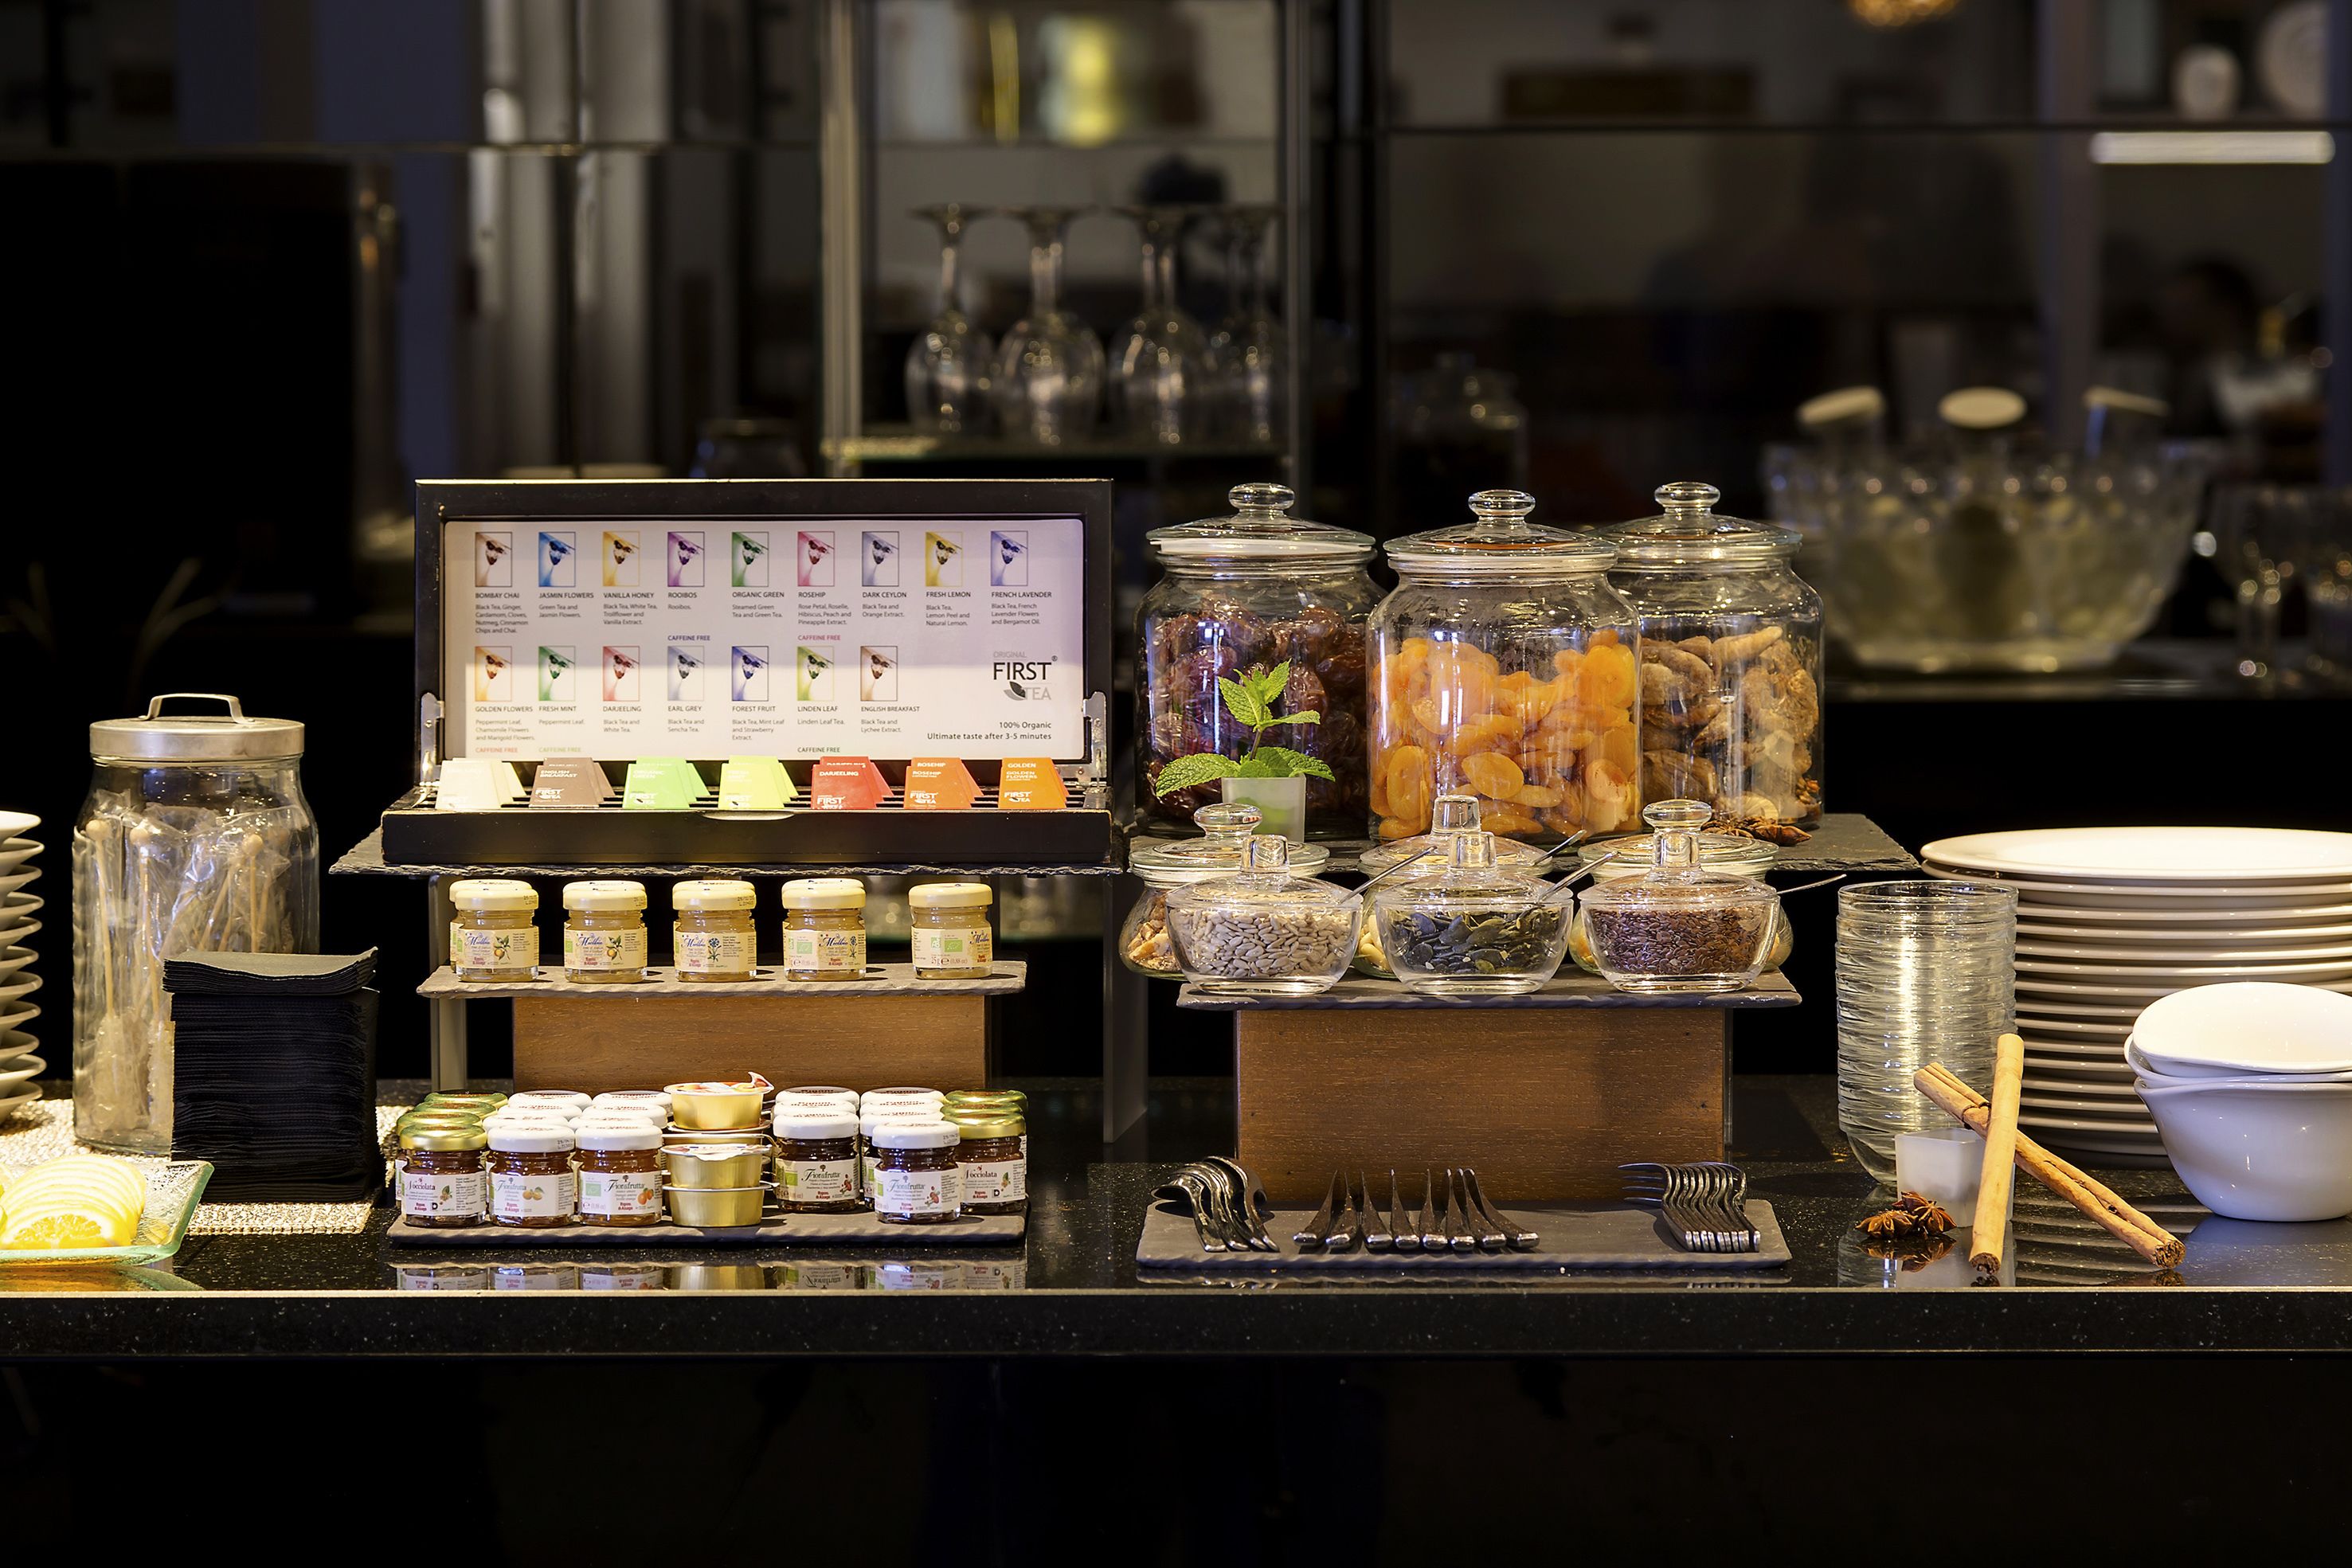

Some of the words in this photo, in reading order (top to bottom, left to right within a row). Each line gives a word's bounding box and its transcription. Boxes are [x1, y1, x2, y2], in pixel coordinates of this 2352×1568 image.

[993, 663, 1052, 681] FIRST
[1023, 688, 1051, 700] TEA
[1022, 721, 1051, 730] Organic
